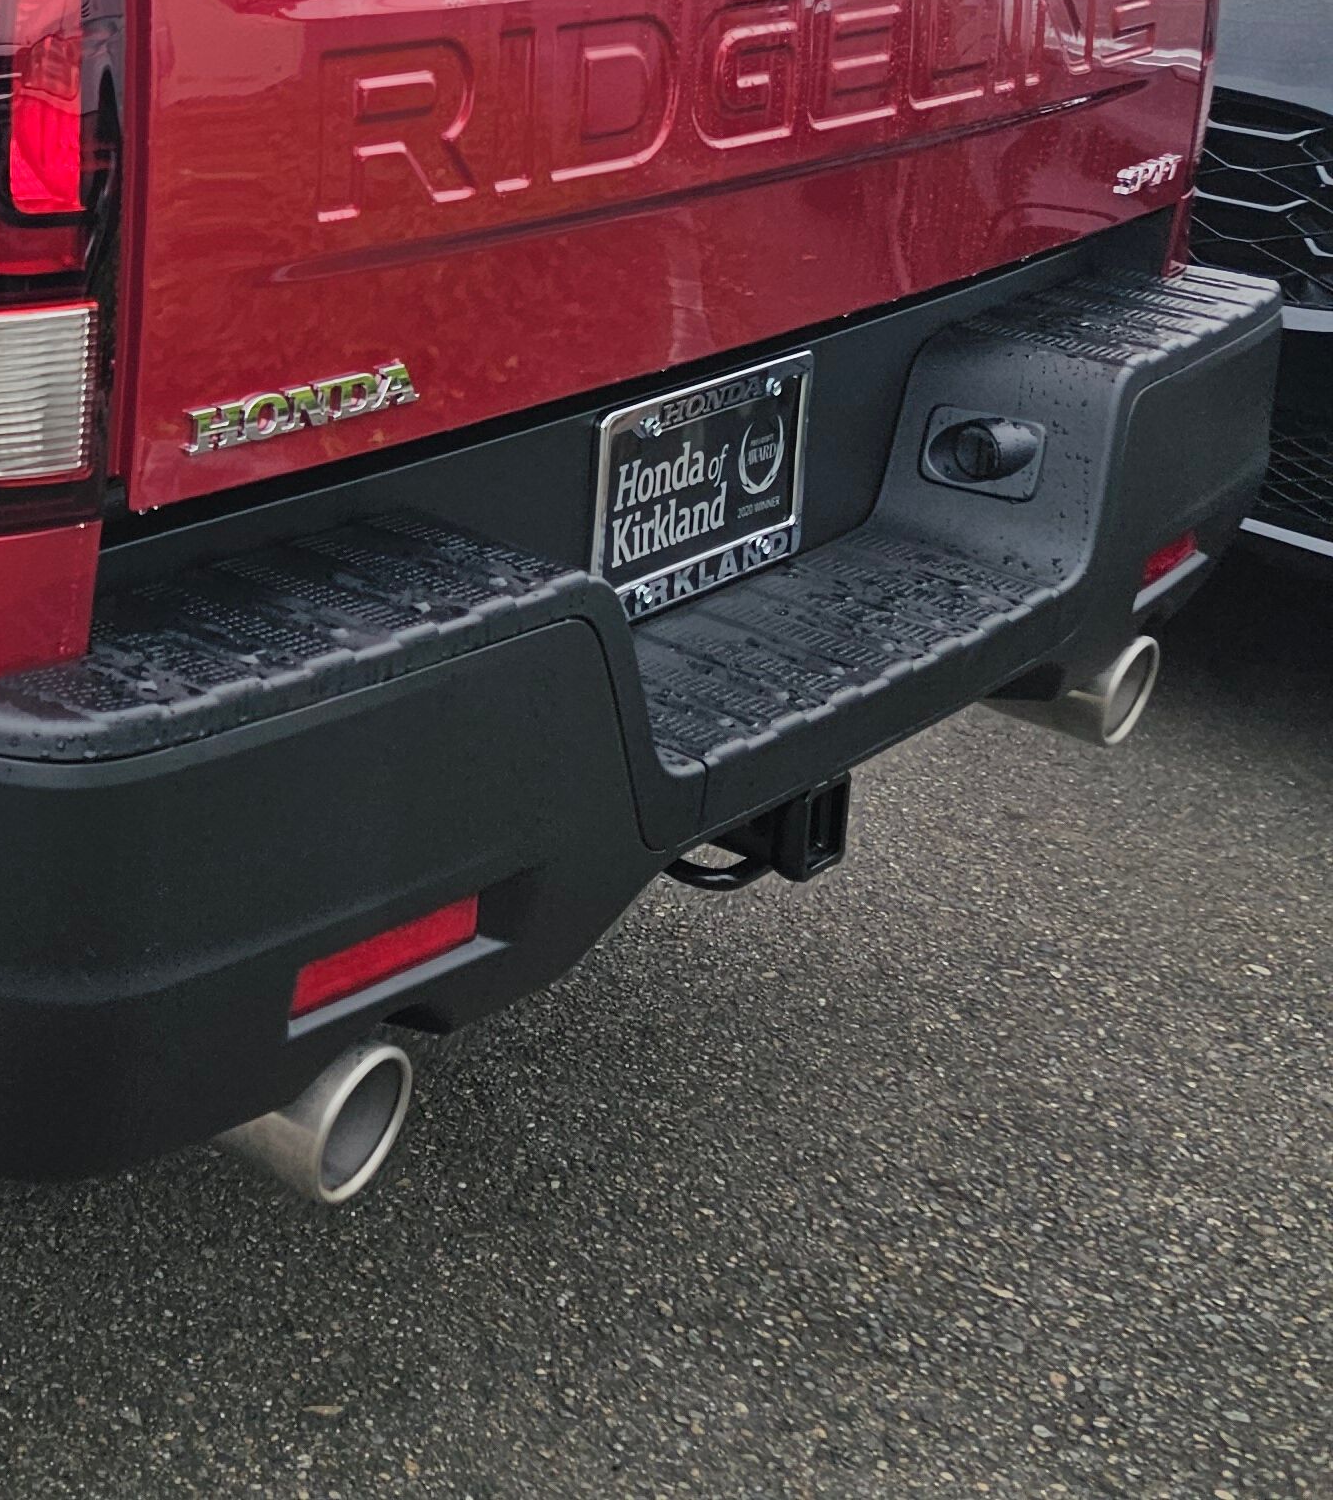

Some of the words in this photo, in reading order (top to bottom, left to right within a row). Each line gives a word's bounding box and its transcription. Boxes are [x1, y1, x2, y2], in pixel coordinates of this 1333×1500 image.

[180, 358, 420, 455] HONDA
[661, 376, 766, 427] HONDA
[613, 441, 705, 512] Honda
[708, 443, 729, 488] of
[611, 481, 728, 568] Kirkland
